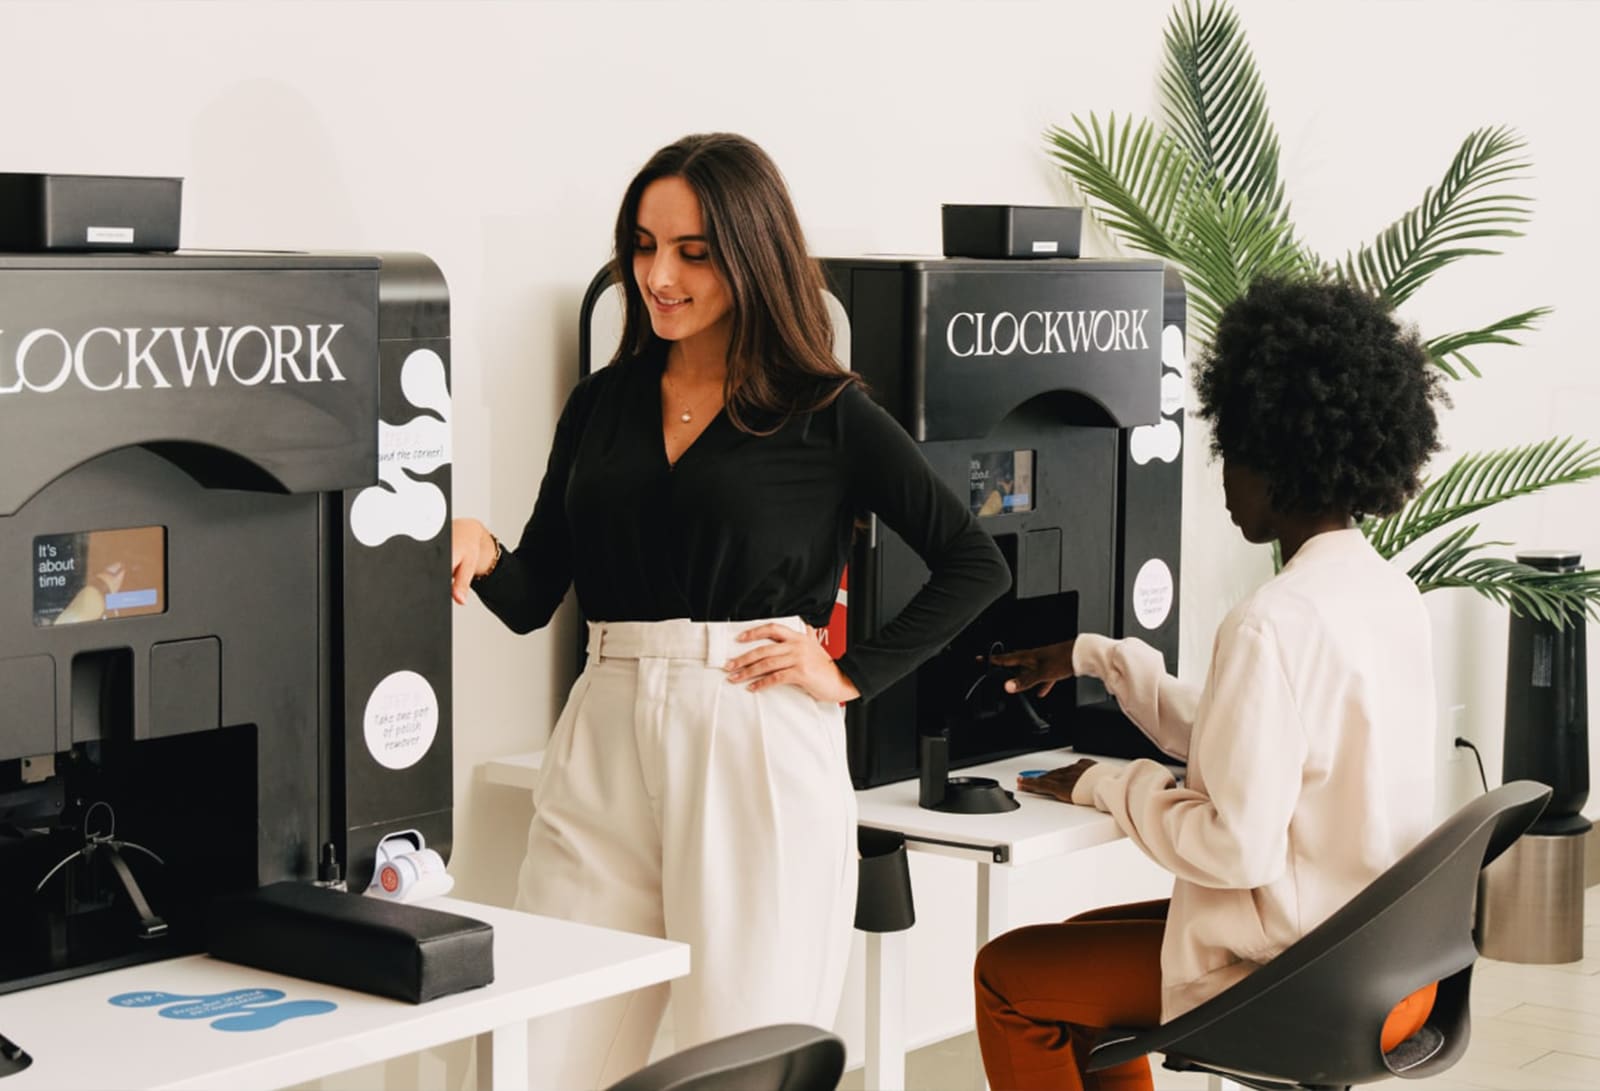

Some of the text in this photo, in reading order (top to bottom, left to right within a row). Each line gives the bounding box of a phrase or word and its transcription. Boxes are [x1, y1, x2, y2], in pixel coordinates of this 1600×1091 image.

[946, 309, 1149, 357] CLOCKWORK
[397, 447, 411, 460] the
[38, 544, 57, 558] It's
[38, 557, 75, 573] about
[38, 574, 66, 588] time
[384, 735, 420, 751] remover
